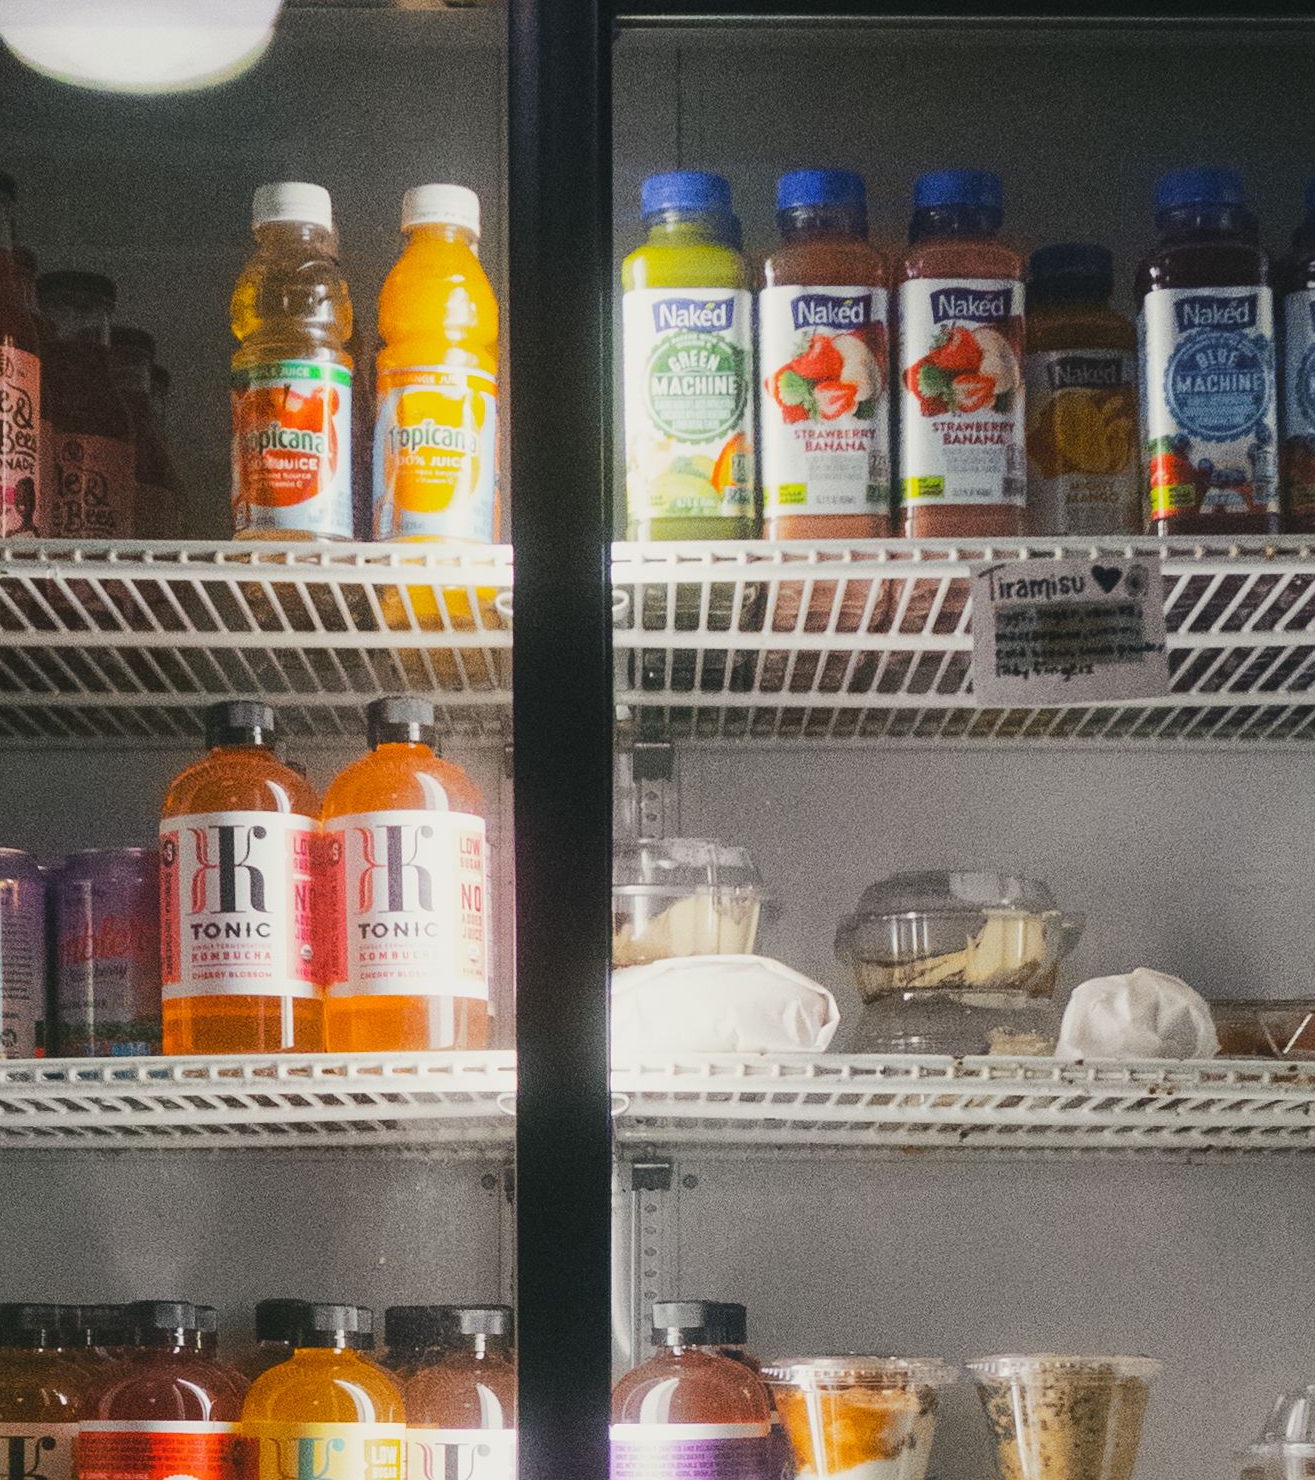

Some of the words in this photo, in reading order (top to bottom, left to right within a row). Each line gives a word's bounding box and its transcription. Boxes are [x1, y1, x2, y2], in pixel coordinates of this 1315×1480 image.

[658, 302, 728, 329] Naked
[797, 300, 865, 325] Naked
[937, 293, 1005, 318] Naked
[1183, 300, 1250, 327] Naked
[667, 349, 722, 372] GREEN
[650, 374, 739, 398] MACHINE
[1175, 373, 1263, 394] MACHINE
[793, 428, 877, 441] STRAWBERRY
[804, 439, 868, 453] BANANA
[977, 562, 1087, 602] Tiramisu
[189, 922, 272, 941] TONIC
[357, 922, 439, 941] TONIC
[190, 951, 273, 962] KOMBUCHA
